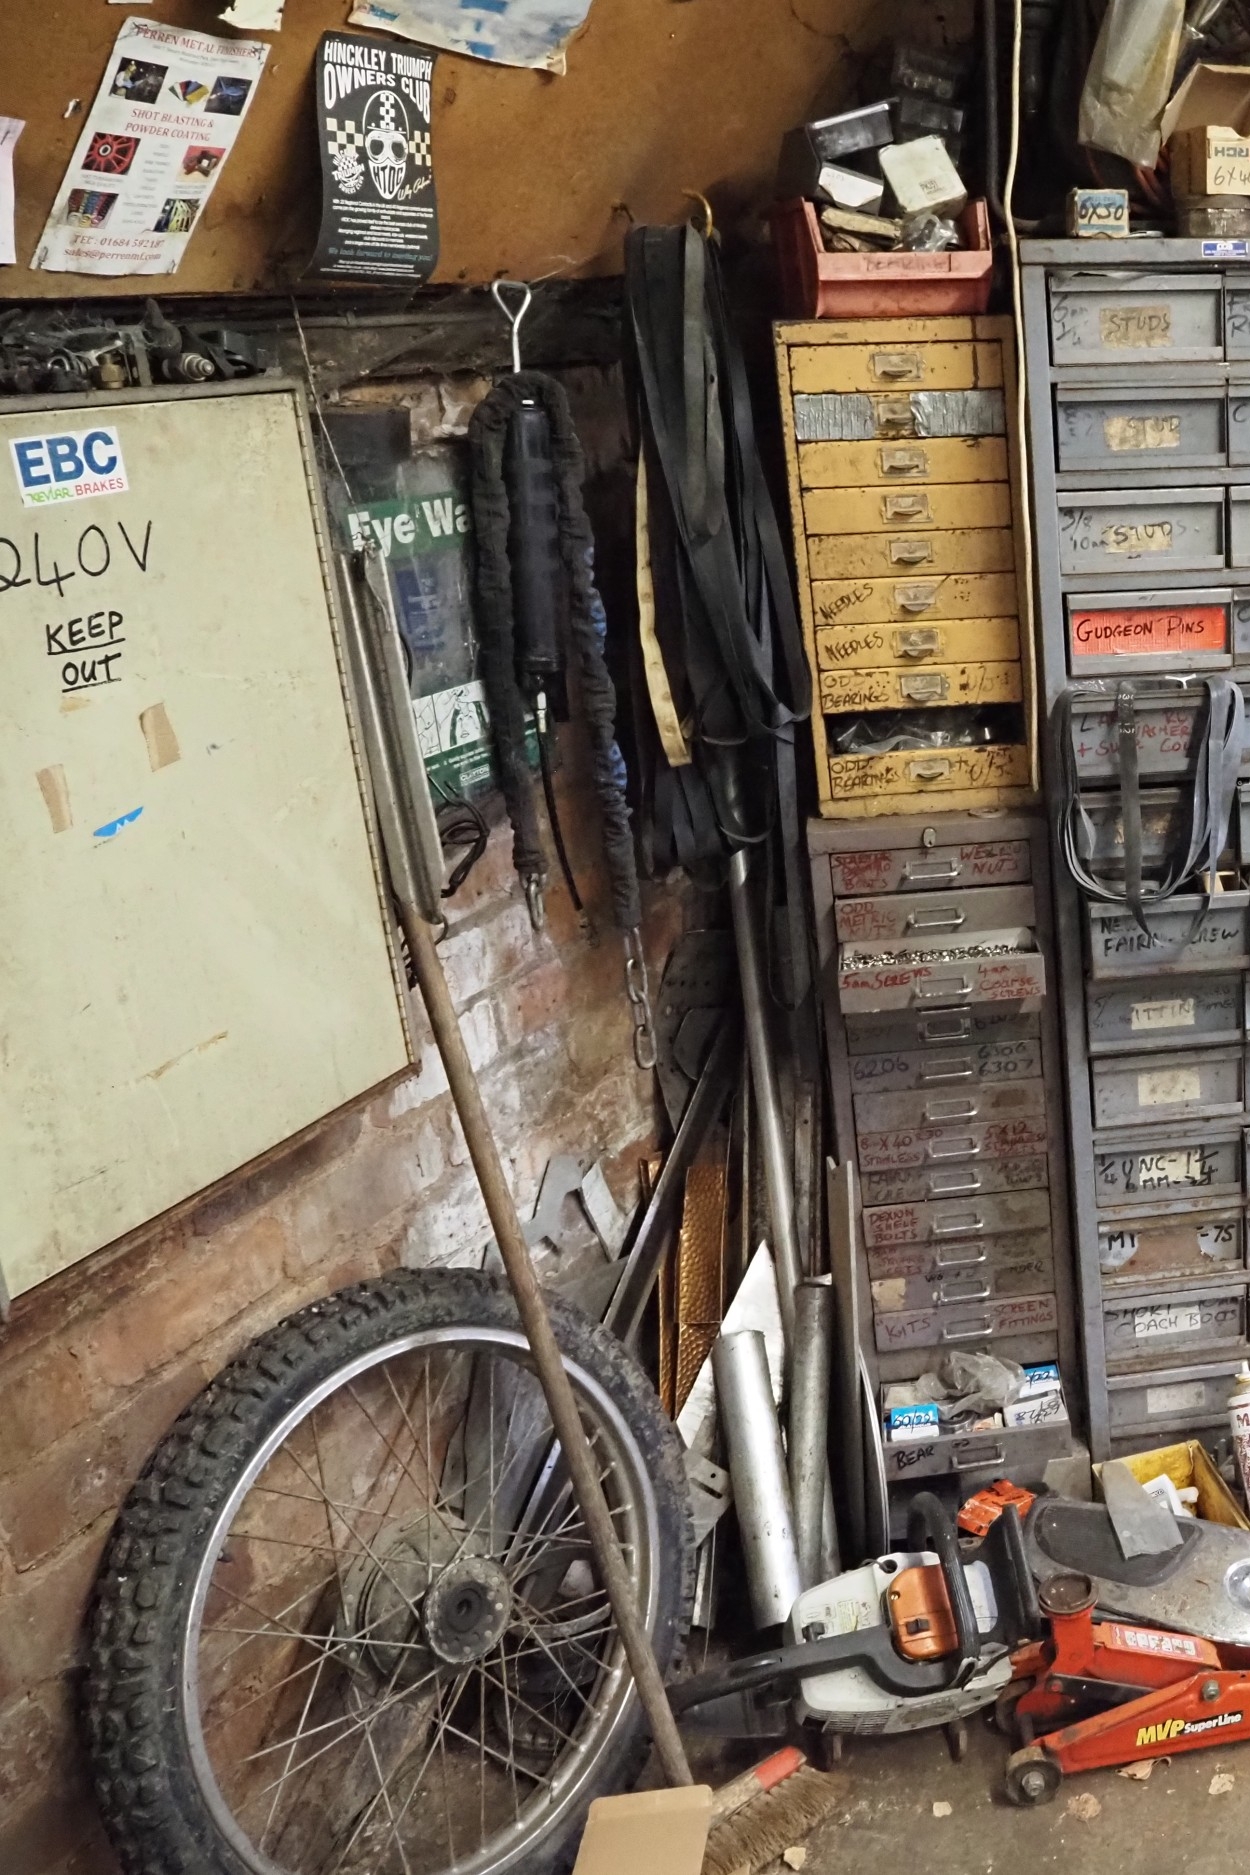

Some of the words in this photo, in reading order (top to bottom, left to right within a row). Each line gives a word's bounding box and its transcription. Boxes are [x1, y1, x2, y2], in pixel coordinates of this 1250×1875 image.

[136, 25, 178, 46] PERREN
[180, 37, 215, 54] METAL
[216, 45, 258, 58] FINISHERS
[324, 40, 386, 71] HINCKLEY
[390, 52, 432, 81] TRIUMPH
[324, 63, 396, 110] OWNERS
[401, 77, 430, 124] CLUB
[131, 108, 160, 121] SHOT
[161, 114, 207, 128] BLASTING
[207, 119, 214, 128] &
[125, 122, 171, 137] POWDER
[170, 129, 211, 142] COATING
[373, 164, 405, 196] HTOC
[74, 234, 93, 246] TEL
[100, 238, 130, 247] 01684
[1109, 313, 1171, 335] STUDS
[15, 431, 118, 488] EBC
[26, 486, 73, 504] KEVLAR
[75, 477, 125, 496] BRAKES
[347, 511, 416, 558] Eye
[421, 497, 471, 538] Wa
[0, 520, 152, 597] 240V
[819, 582, 874, 620] NEEDLES
[46, 611, 124, 652] KEEP
[1077, 618, 1153, 643] GUDGEON
[1166, 615, 1205, 637] PINS
[825, 632, 884, 662] NEEDLES
[61, 653, 122, 686] OUT
[822, 691, 891, 711] BEARINGS
[972, 858, 1019, 876] NUTS
[839, 902, 875, 915] ODD
[839, 911, 897, 929] METRIC
[874, 1227, 918, 1244] BOLTS
[994, 1299, 1049, 1317] SCREEN
[997, 1311, 1054, 1330] FITTINGS
[1113, 1315, 1178, 1338] COACH
[892, 1444, 935, 1471] BEAR
[1136, 1720, 1185, 1747] MVP
